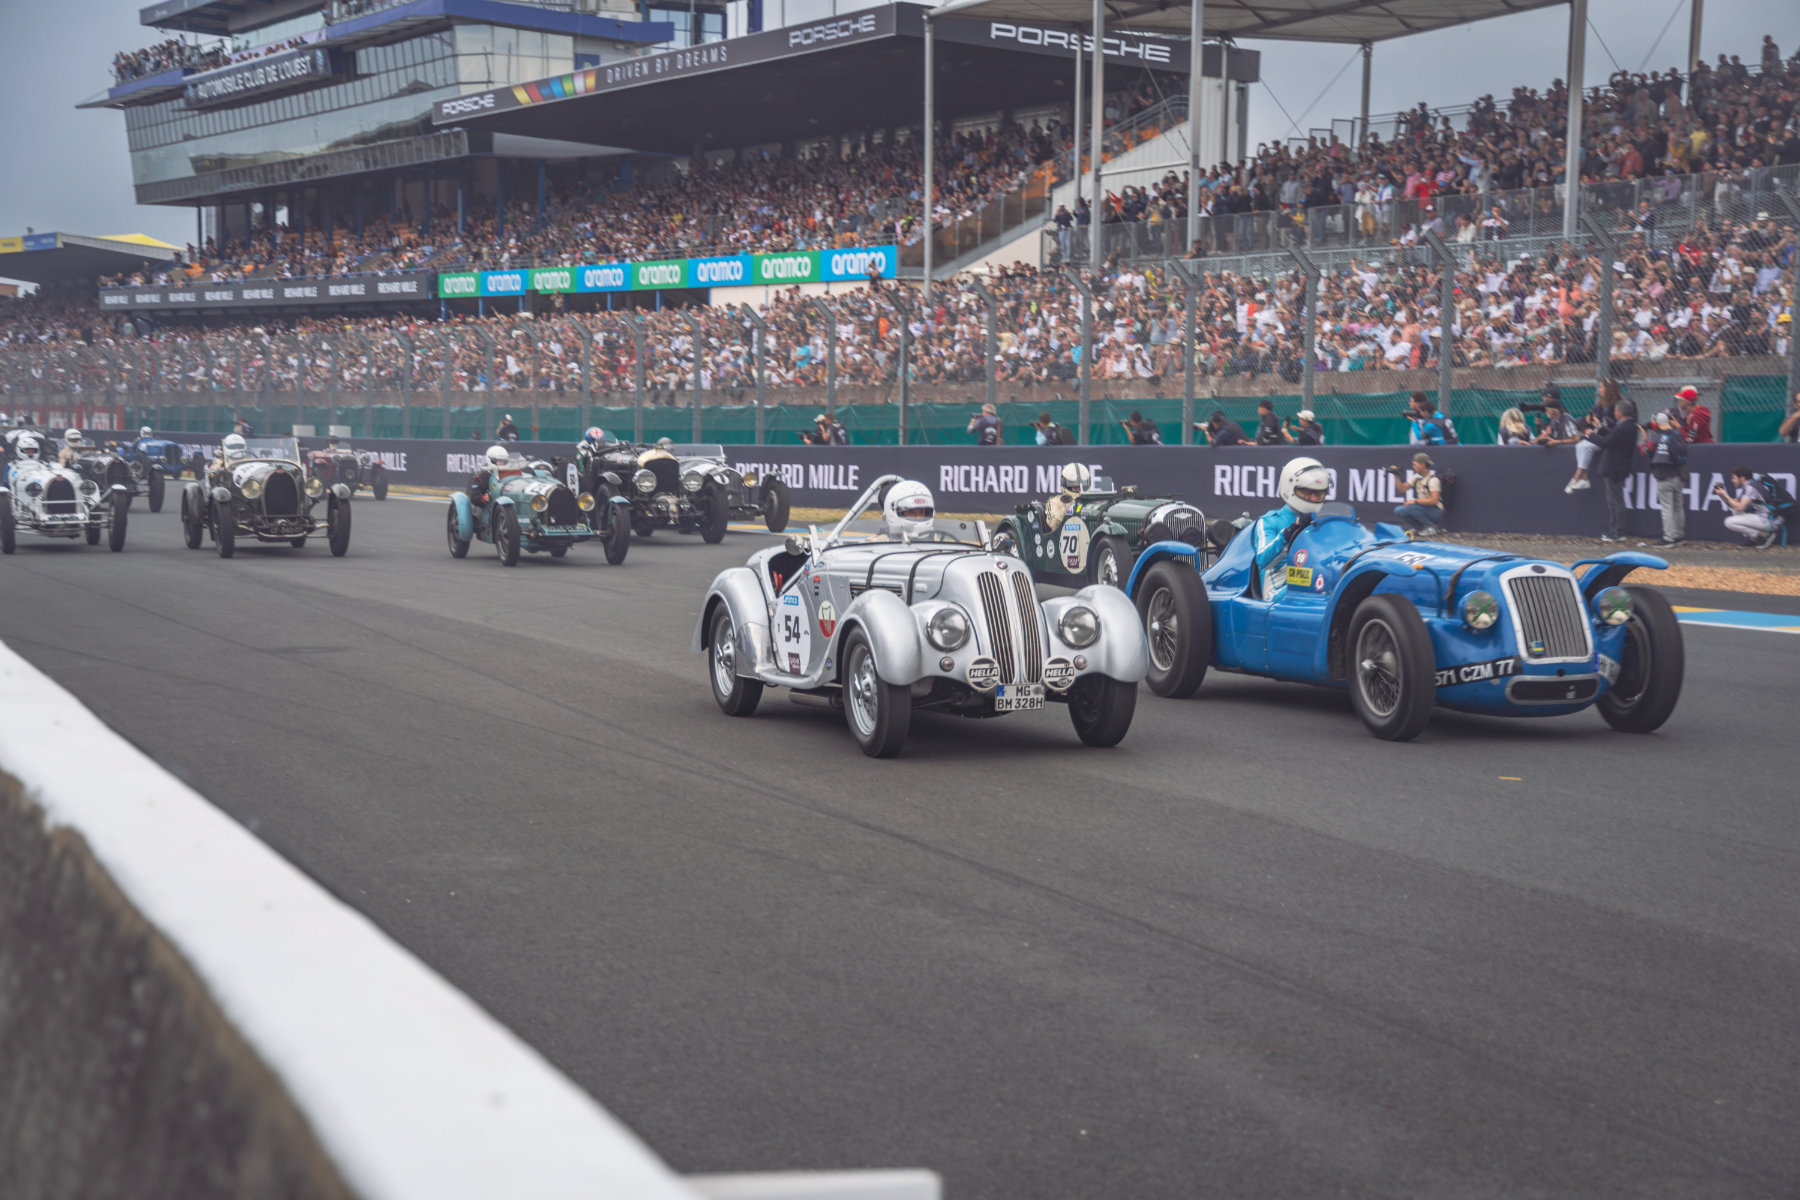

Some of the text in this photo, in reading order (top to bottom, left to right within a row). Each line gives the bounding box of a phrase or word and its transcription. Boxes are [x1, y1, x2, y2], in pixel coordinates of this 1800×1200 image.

[789, 14, 876, 48] PORSCHE
[990, 22, 1172, 62] PORSCHE
[606, 46, 728, 84] DRIVEN BY DREAMS
[197, 76, 244, 100] AUTOMOBILE
[244, 68, 265, 88] CLUB
[442, 93, 495, 116] PORSCHE
[697, 260, 743, 282] aramco
[761, 256, 811, 279] aramco
[831, 252, 886, 275] aramco
[444, 276, 476, 294] aramco
[487, 273, 522, 292] aramco
[534, 271, 571, 290] aramco
[584, 268, 624, 288] aramco
[639, 264, 681, 286] aramco
[446, 453, 487, 473] RICHAR
[808, 464, 859, 490] MILLE
[939, 465, 1103, 494] RICHARD MIE
[1214, 465, 1436, 503] RICHD MILL
[1062, 535, 1078, 554] 70
[784, 614, 801, 645] 54
[970, 668, 999, 678] HELLA
[1046, 668, 1074, 678] HELLA
[1460, 663, 1494, 682] CZM
[1496, 659, 1515, 676] 77
[1015, 686, 1031, 697] MG
[997, 697, 1044, 710] BM 328H
